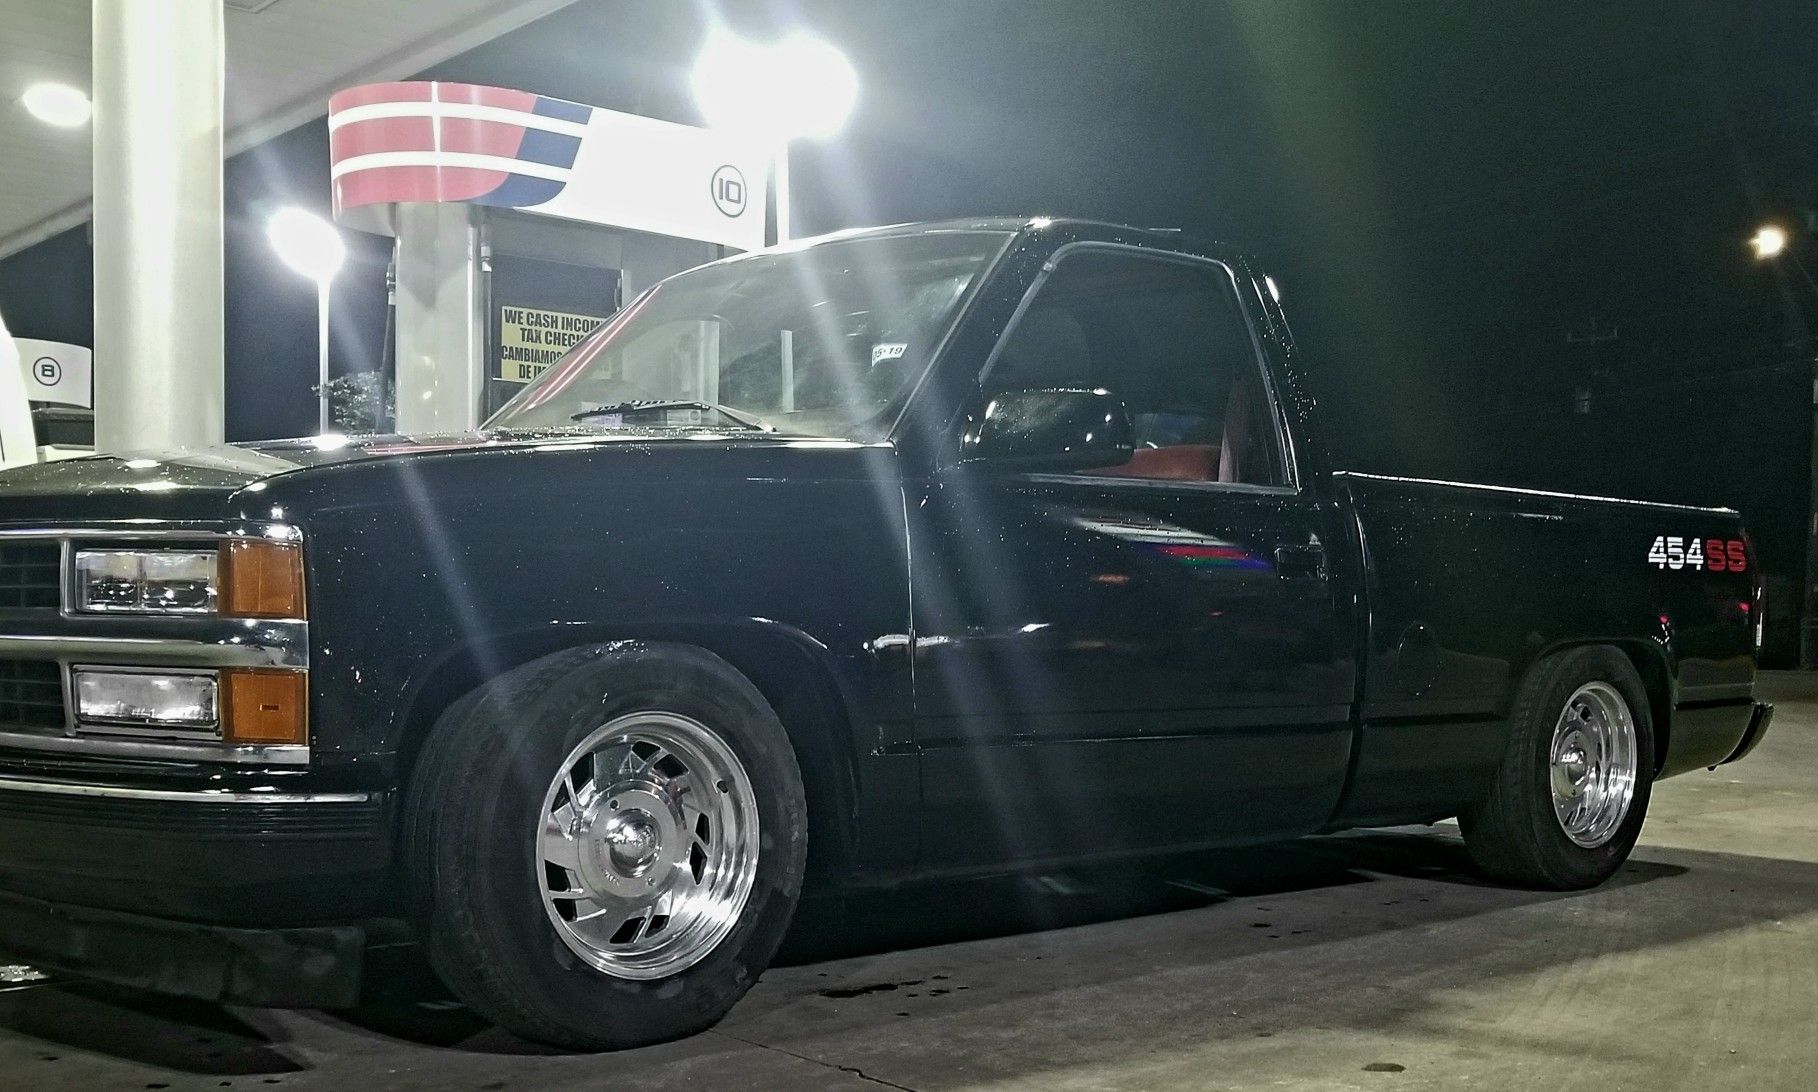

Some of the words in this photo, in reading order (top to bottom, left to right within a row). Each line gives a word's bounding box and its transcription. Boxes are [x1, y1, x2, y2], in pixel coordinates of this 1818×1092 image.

[719, 178, 741, 204] 10
[504, 309, 523, 325] WE
[527, 312, 558, 330] CASH
[561, 317, 602, 333] INCOM
[520, 328, 541, 344] TAX
[519, 364, 531, 379] DE
